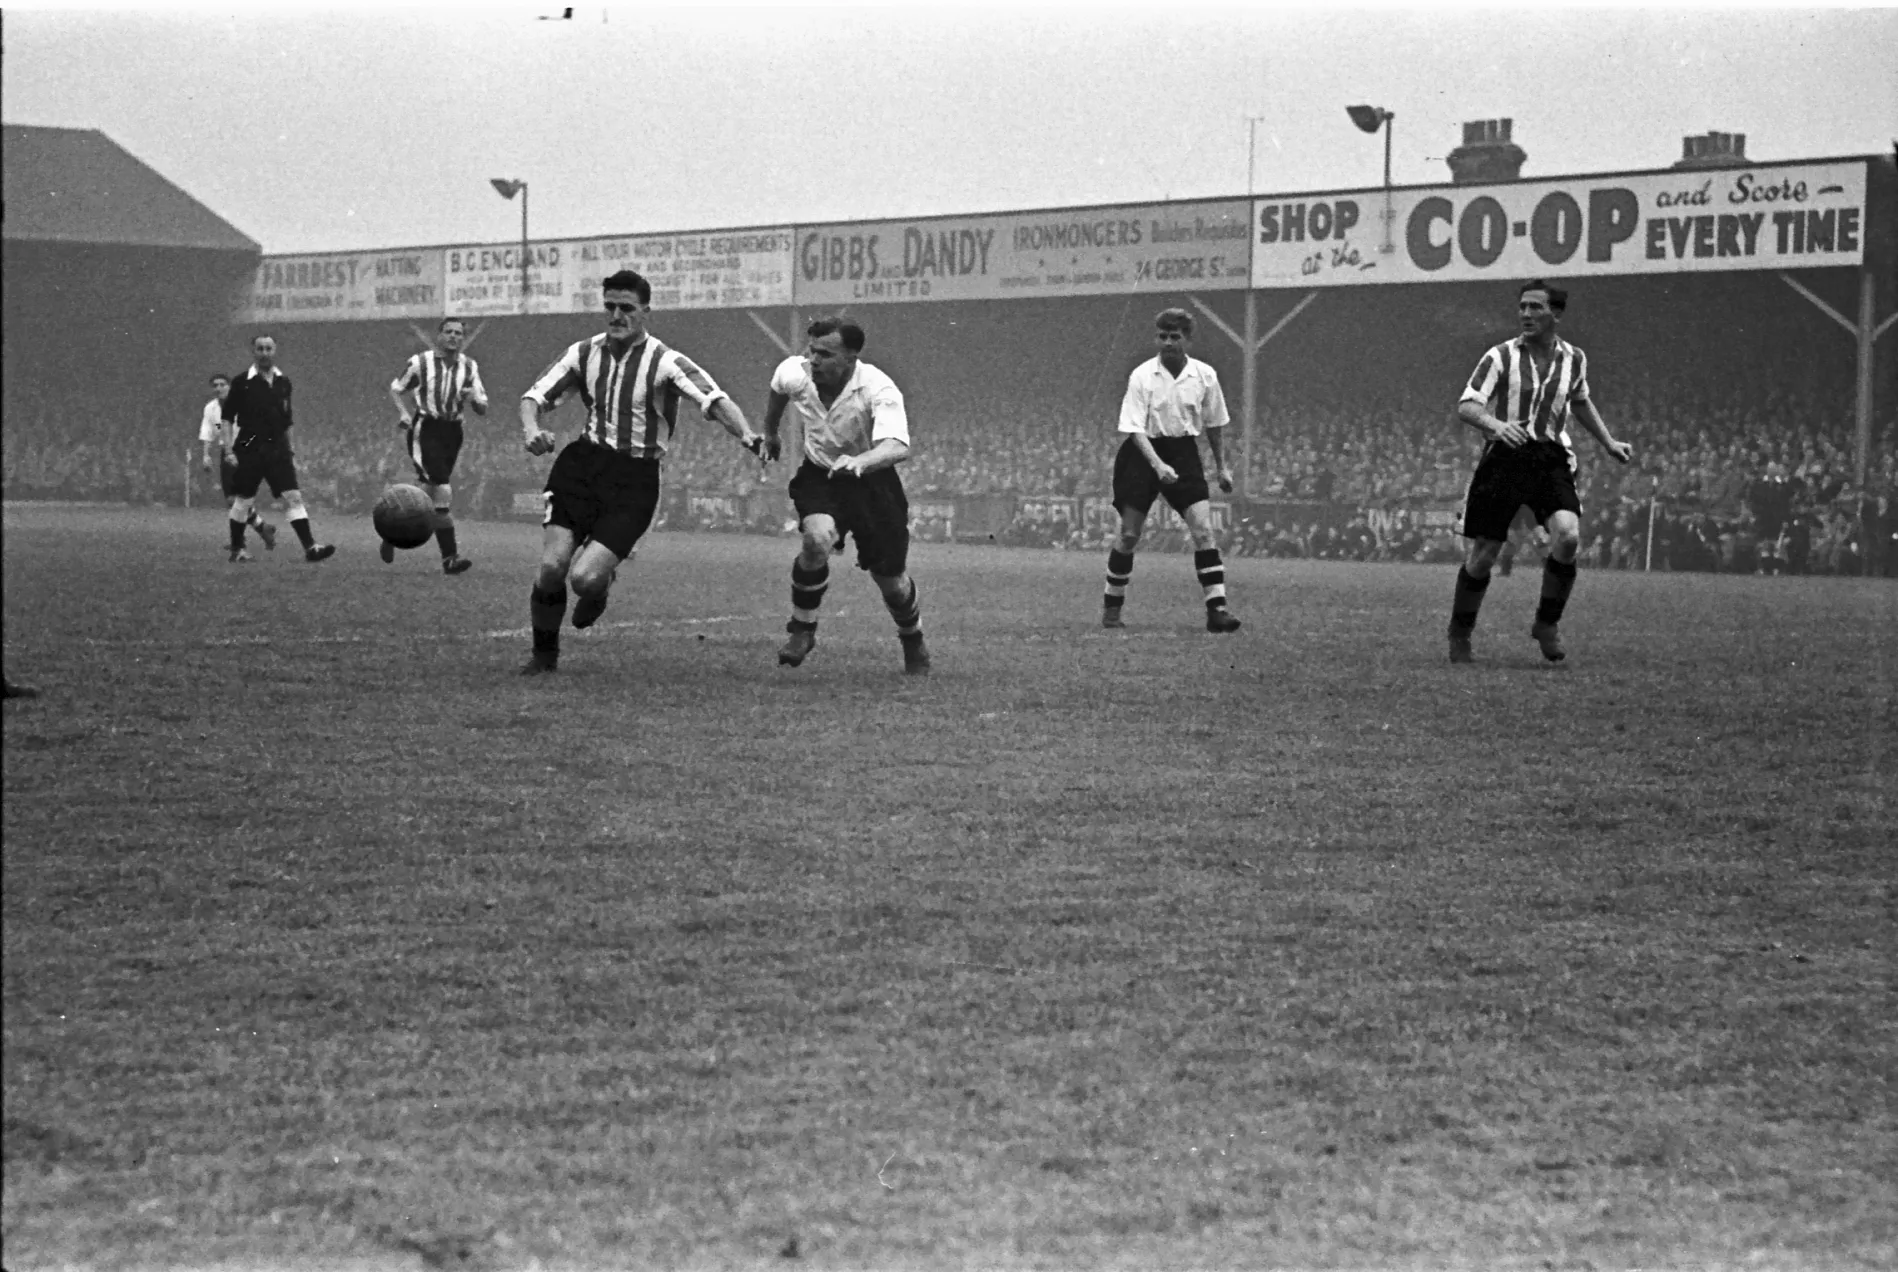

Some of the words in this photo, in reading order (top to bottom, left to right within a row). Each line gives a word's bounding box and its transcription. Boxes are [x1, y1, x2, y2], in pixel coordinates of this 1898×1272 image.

[1656, 179, 1712, 208] and
[1728, 173, 1808, 204] Score
[1013, 219, 1142, 251] IRONMONGERS
[1260, 200, 1359, 243] SHOP
[1406, 188, 1639, 271] CO-OP
[1645, 212, 1765, 260] EVERY
[1773, 207, 1860, 255] TIME
[801, 232, 879, 281] GIBBS
[903, 226, 995, 278] DANDY
[1302, 252, 1323, 276] at
